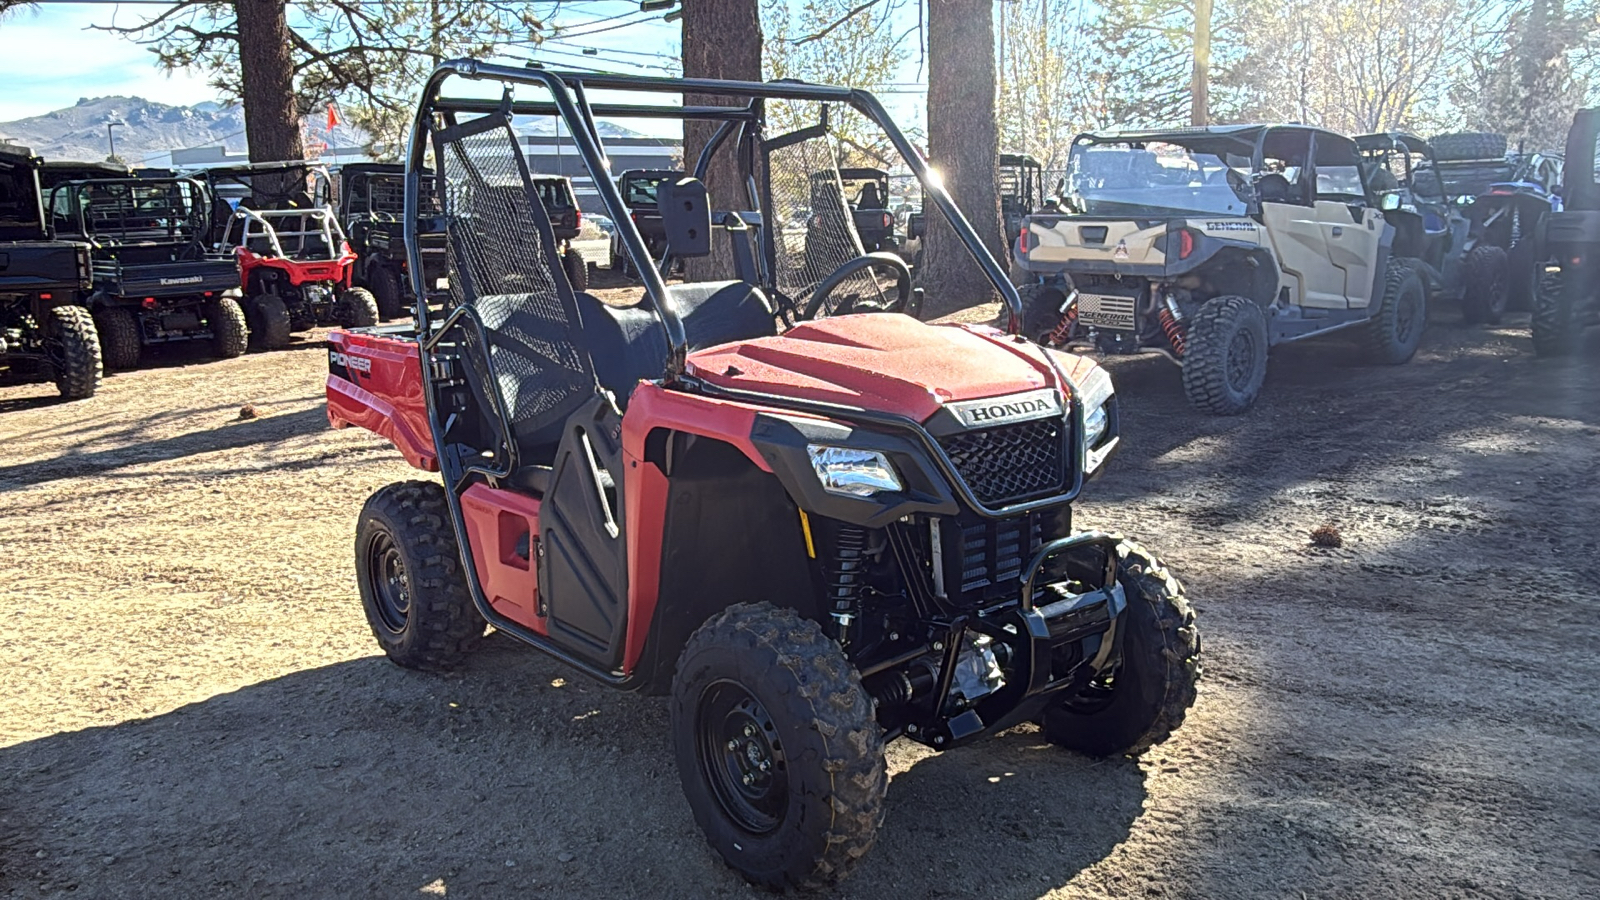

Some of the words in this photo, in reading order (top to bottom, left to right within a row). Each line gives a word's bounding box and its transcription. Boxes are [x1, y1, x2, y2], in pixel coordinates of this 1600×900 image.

[1206, 221, 1256, 232] GENERAL
[160, 275, 203, 285] Kawasaki
[1084, 311, 1130, 321] GENERAL
[330, 351, 371, 373] PIONEER
[969, 399, 1051, 421] HONDA
